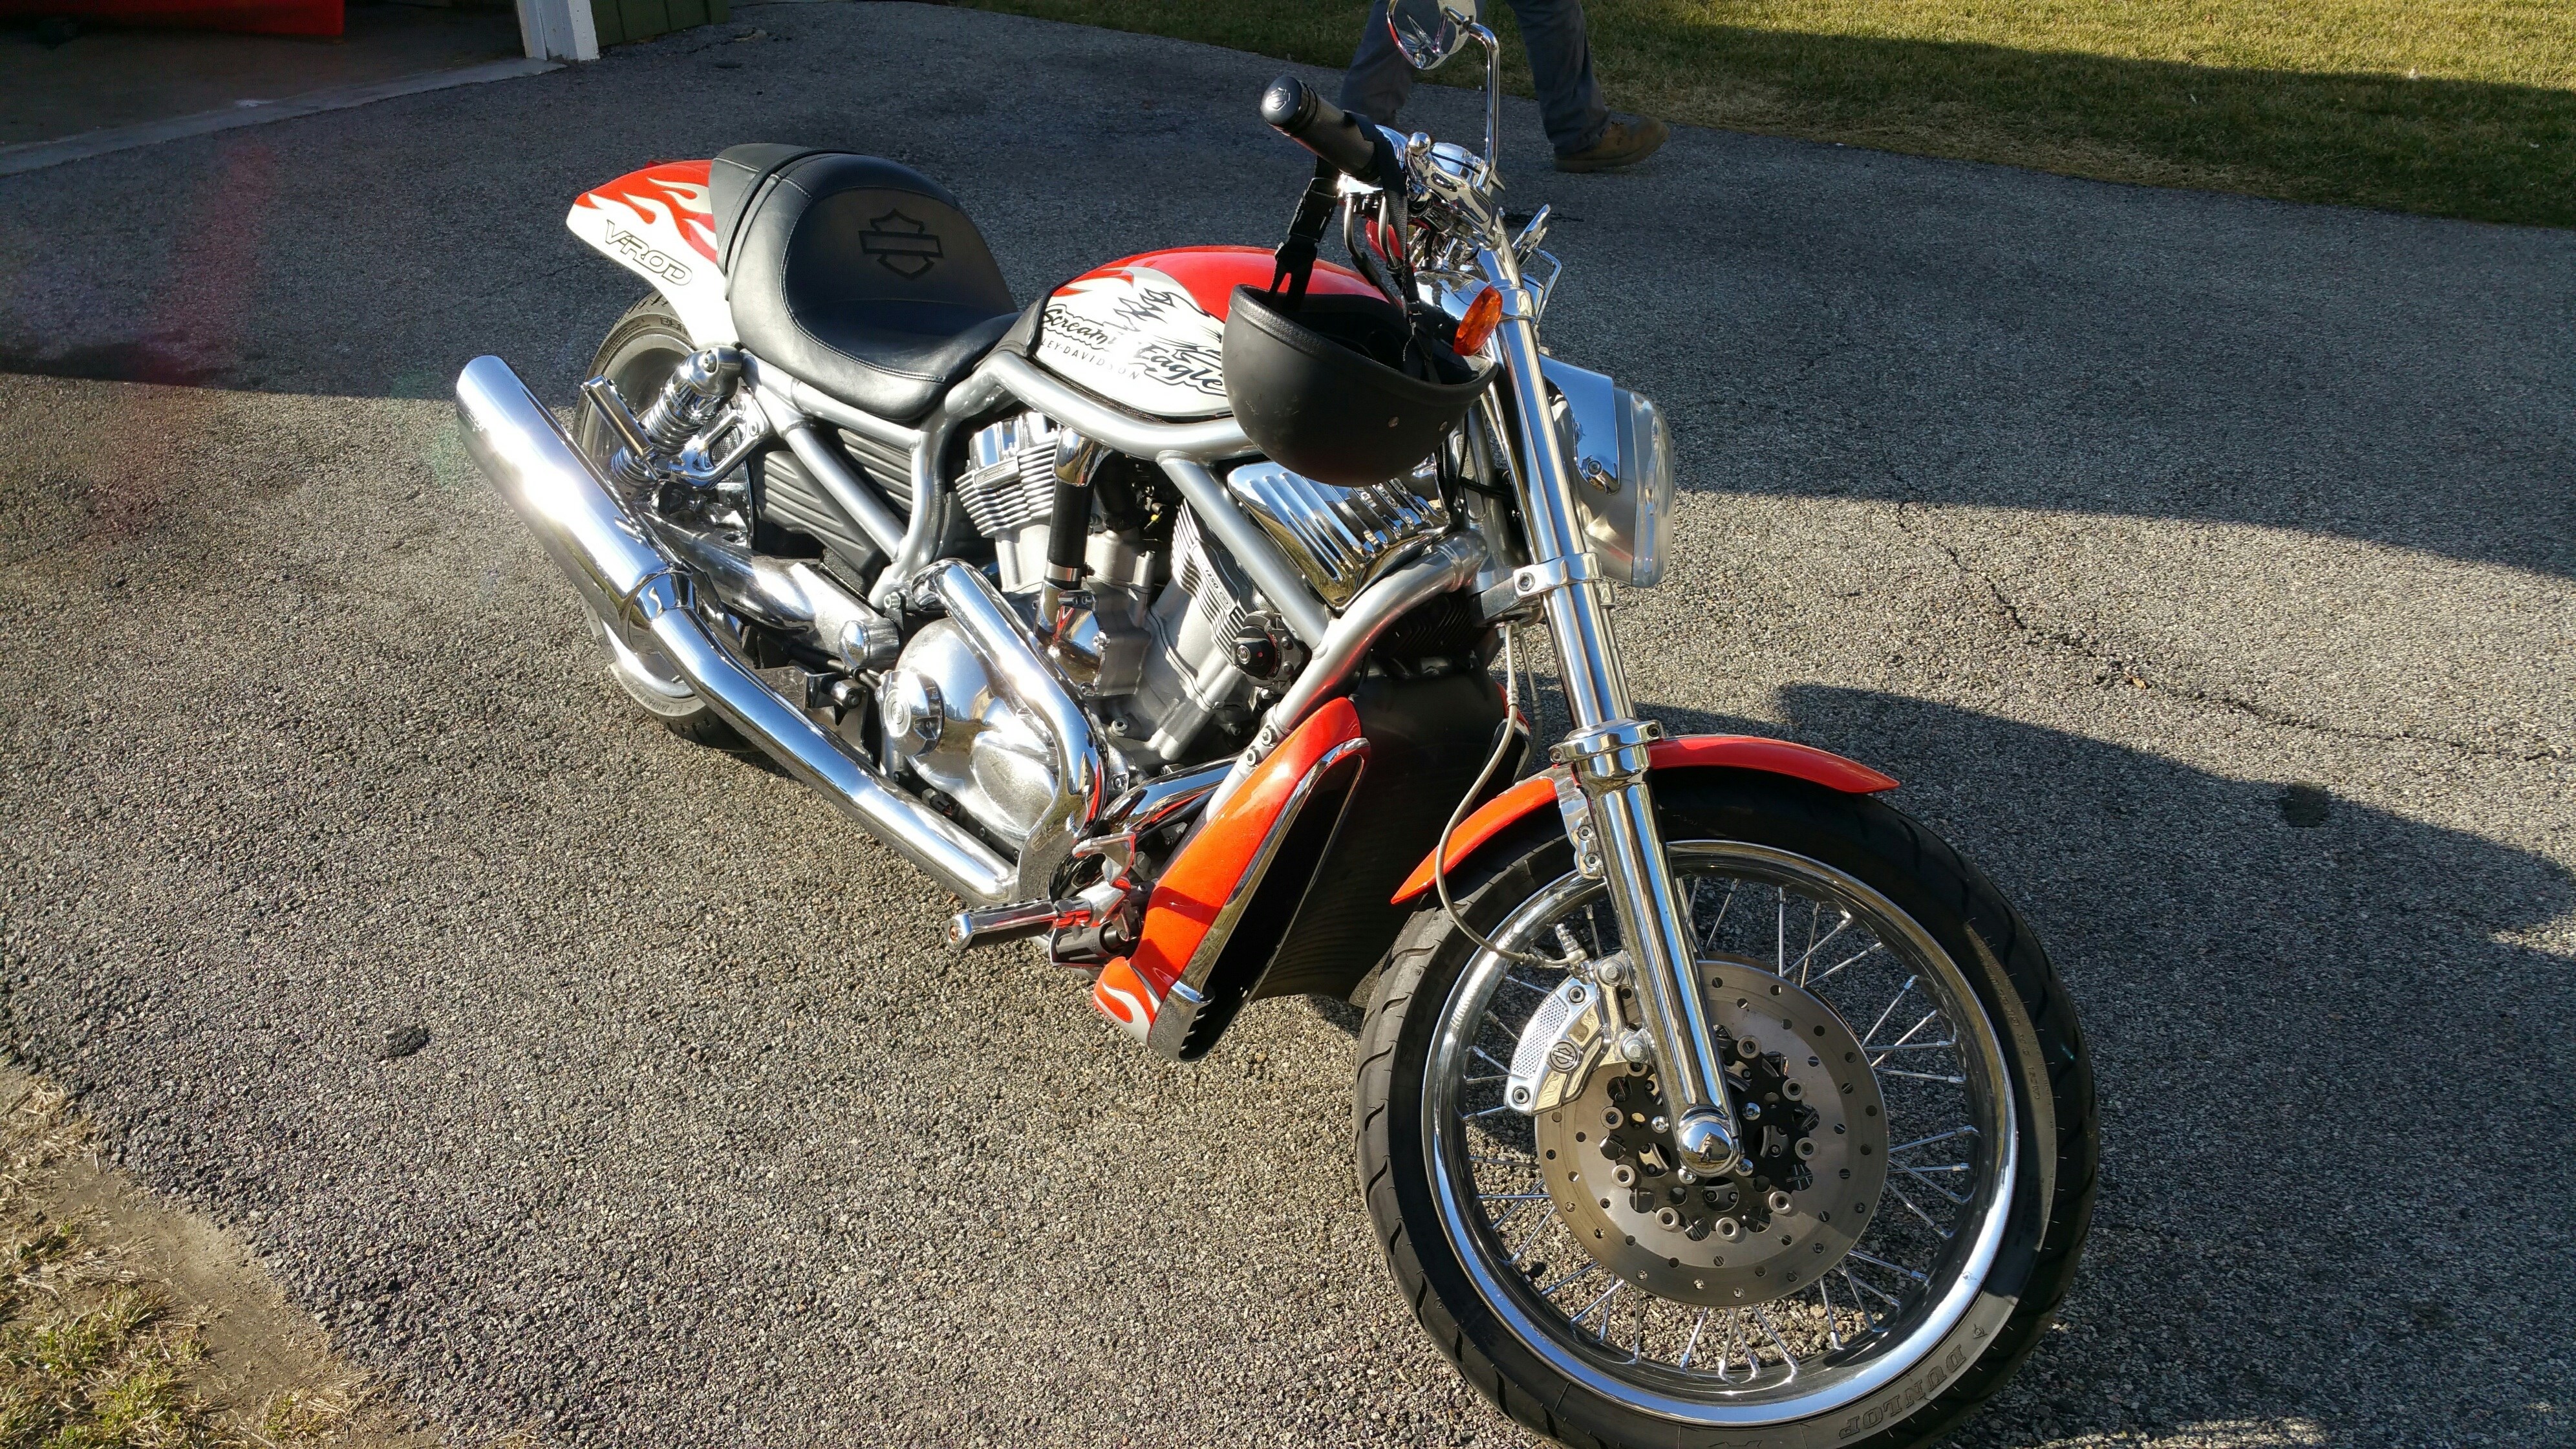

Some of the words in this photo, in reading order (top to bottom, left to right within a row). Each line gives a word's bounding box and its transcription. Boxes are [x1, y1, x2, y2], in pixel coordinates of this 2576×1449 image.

[605, 219, 692, 286] V-ROD
[1133, 341, 1226, 392] Eagle
[1205, 569, 1219, 589] 1250
[1838, 1343, 1967, 1439] DUNLOP
